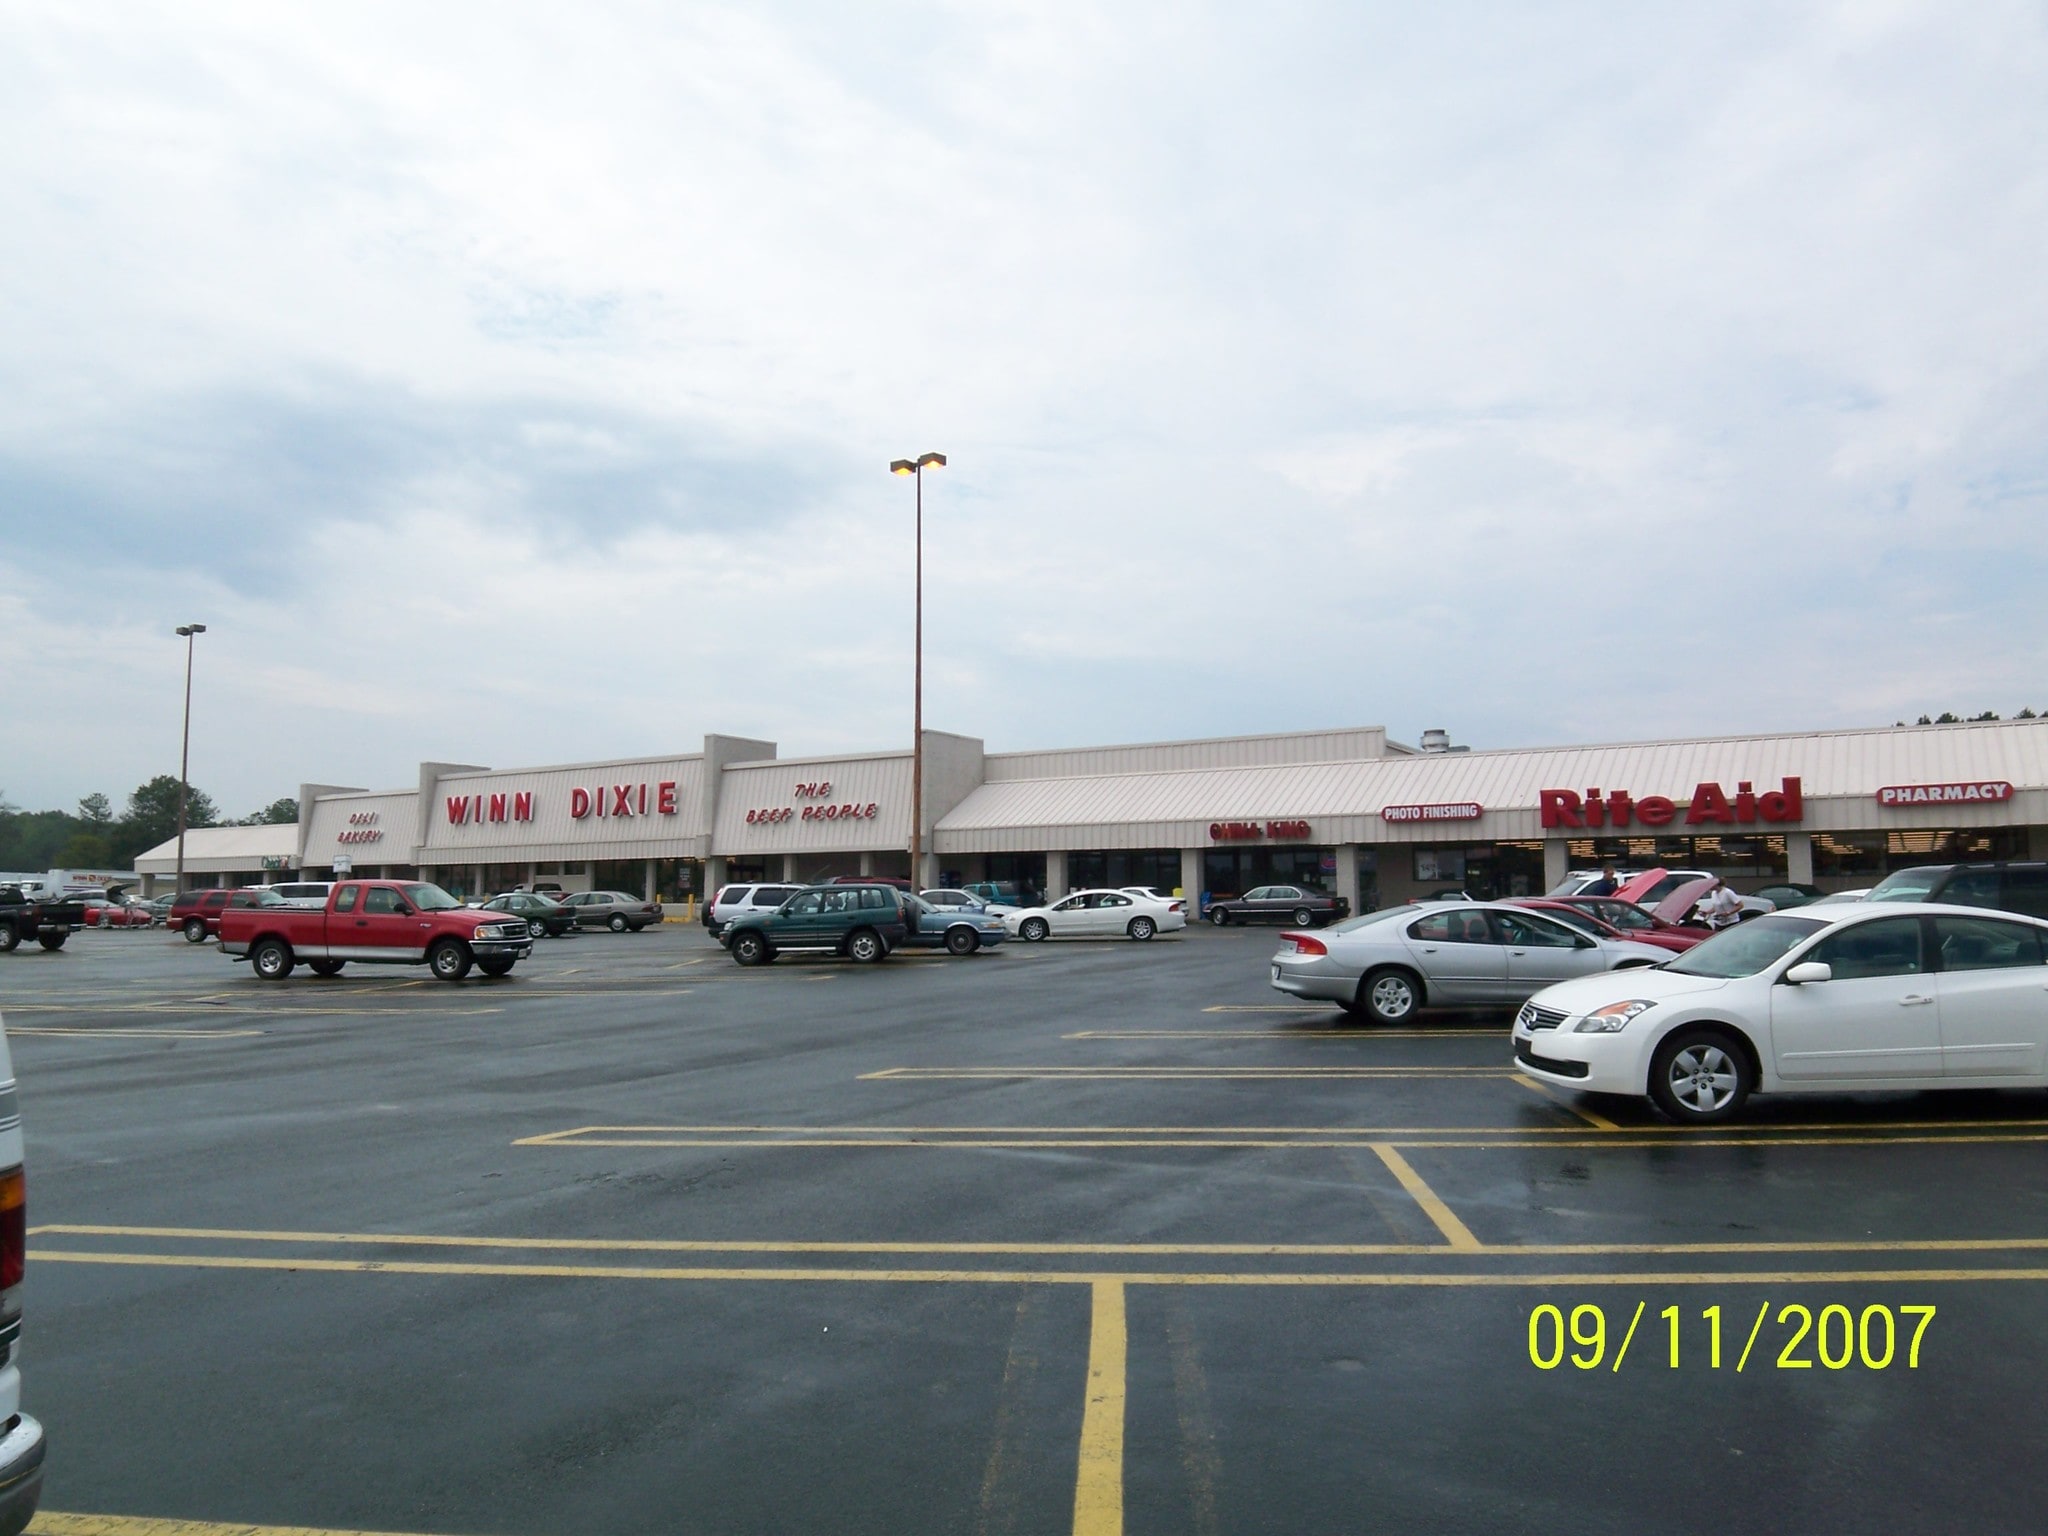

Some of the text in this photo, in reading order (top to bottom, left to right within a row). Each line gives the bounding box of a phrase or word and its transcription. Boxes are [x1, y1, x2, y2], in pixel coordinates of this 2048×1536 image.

[794, 782, 831, 798] THE
[1882, 784, 2007, 803] PHARMACY
[447, 781, 678, 824] WINN DIXIE
[1540, 777, 1803, 828] Rite Aid
[746, 803, 877, 824] BEEF PEOPLE
[1385, 805, 1478, 820] PHOTO FINISHING
[337, 831, 383, 843] BAKERY
[1266, 820, 1311, 839] KING
